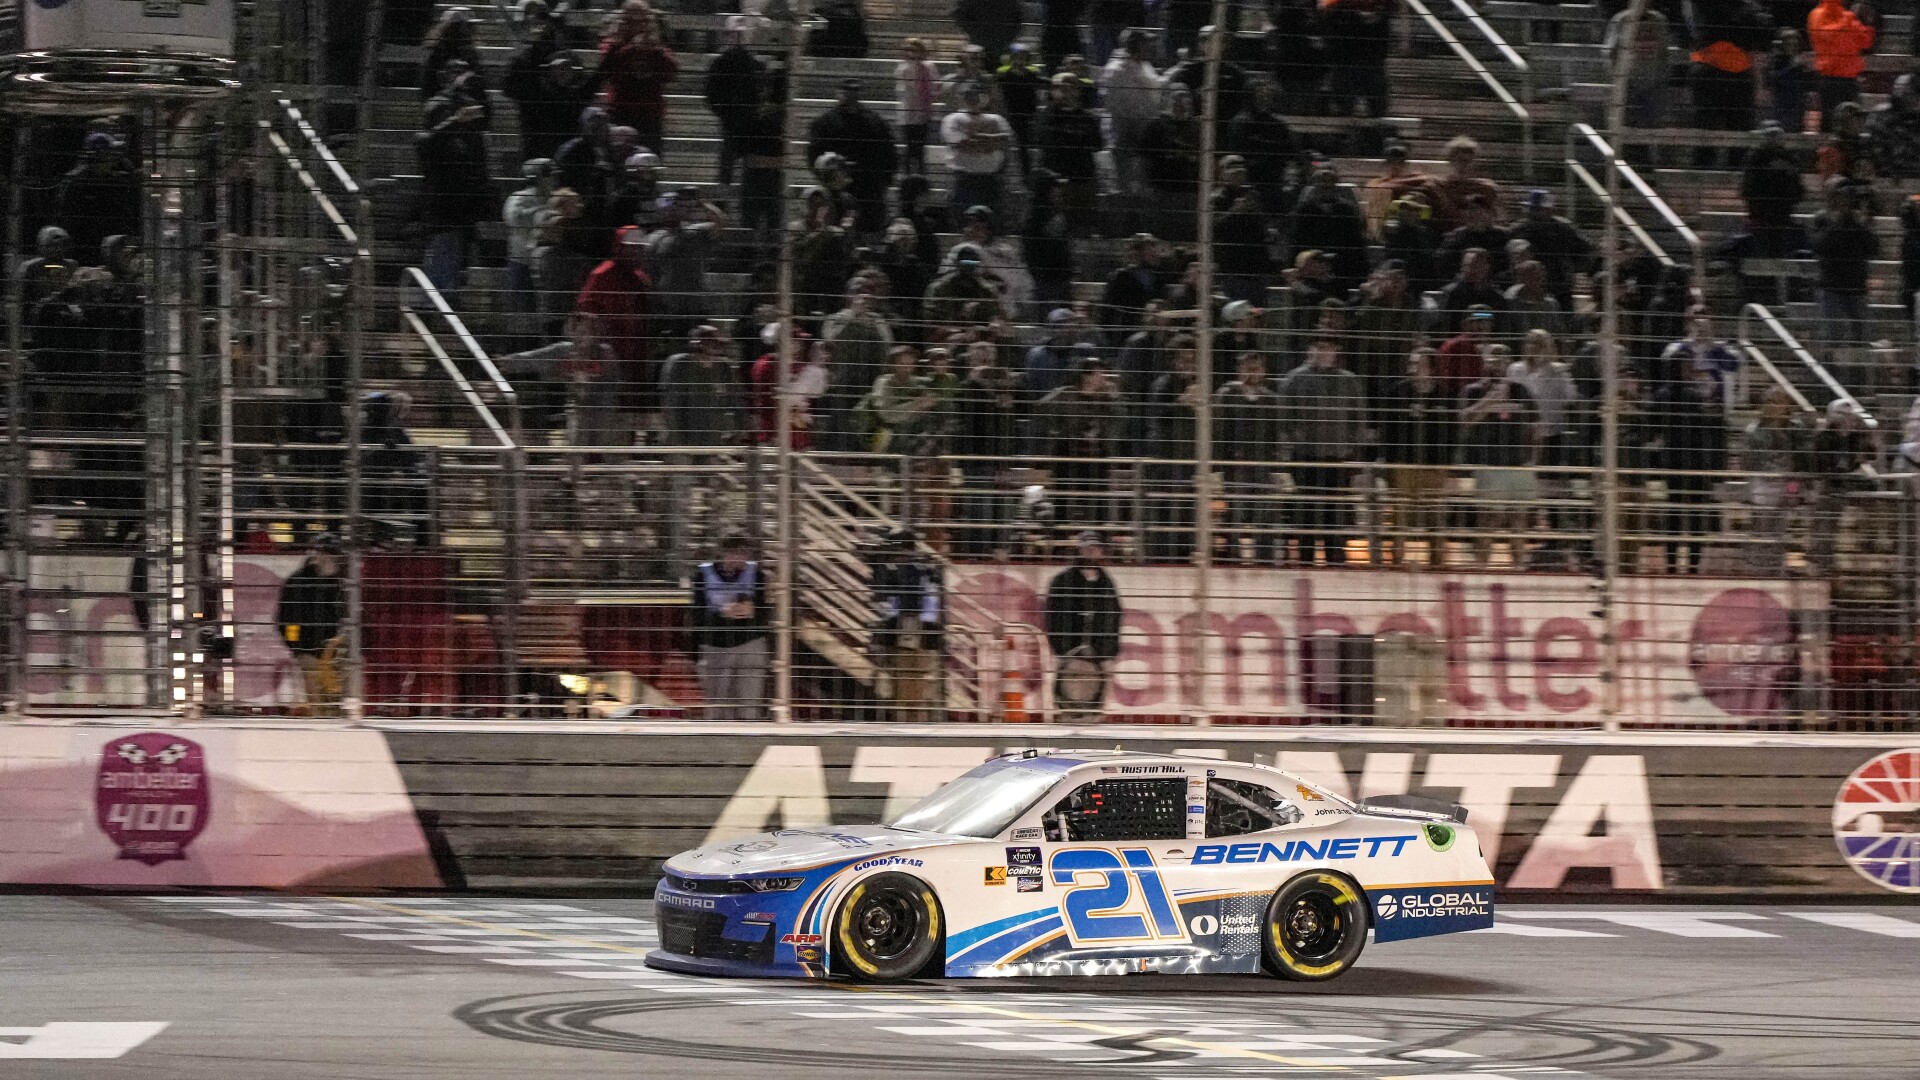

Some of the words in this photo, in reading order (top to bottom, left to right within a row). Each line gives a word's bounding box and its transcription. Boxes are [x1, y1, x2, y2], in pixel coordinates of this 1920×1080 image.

[1160, 765, 1186, 773] HILL
[106, 803, 198, 831] 400
[1315, 808, 1336, 816] John
[1191, 835, 1417, 865] BENNETT
[1012, 852, 1036, 861] xfinity
[853, 855, 924, 872] GOODYEAR
[1008, 866, 1042, 875] COMETIC
[658, 892, 715, 909] CAMARO
[1048, 847, 1185, 943] 21
[1401, 892, 1489, 908] GLOBAL
[1401, 906, 1489, 918] INDUSTRIAL
[1220, 914, 1256, 924] United
[1219, 925, 1259, 935] Rentals
[780, 934, 823, 943] ARP
